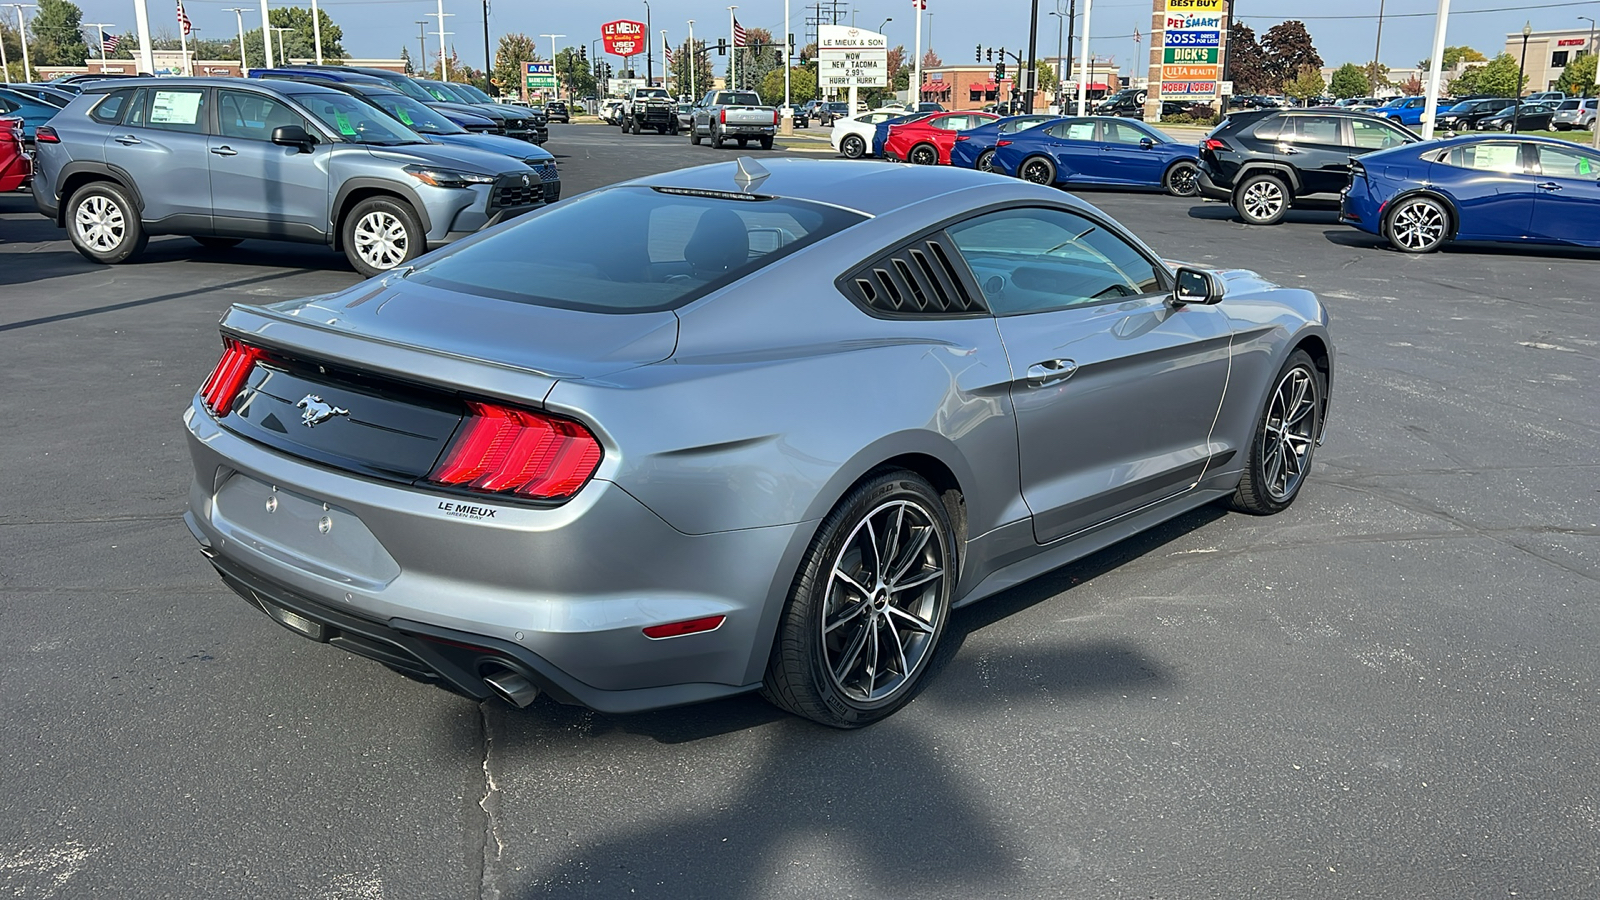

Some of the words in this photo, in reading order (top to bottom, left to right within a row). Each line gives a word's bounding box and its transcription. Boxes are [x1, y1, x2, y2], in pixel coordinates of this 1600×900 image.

[605, 25, 614, 34] LE
[616, 22, 640, 34] MIEUX
[1167, 17, 1220, 29] PETSMART
[1166, 34, 1196, 44] ROSS
[845, 52, 860, 60] WOW
[1174, 48, 1209, 60] DICK'S
[538, 65, 555, 73] ALD
[832, 61, 846, 69] NEW
[1165, 66, 1188, 76] ULTA
[1189, 68, 1216, 76] BEAUTY
[1161, 82, 1189, 92] HOBBY
[1190, 82, 1215, 92] LOBBY
[438, 501, 454, 511] LE
[455, 504, 497, 518] MIEUX
